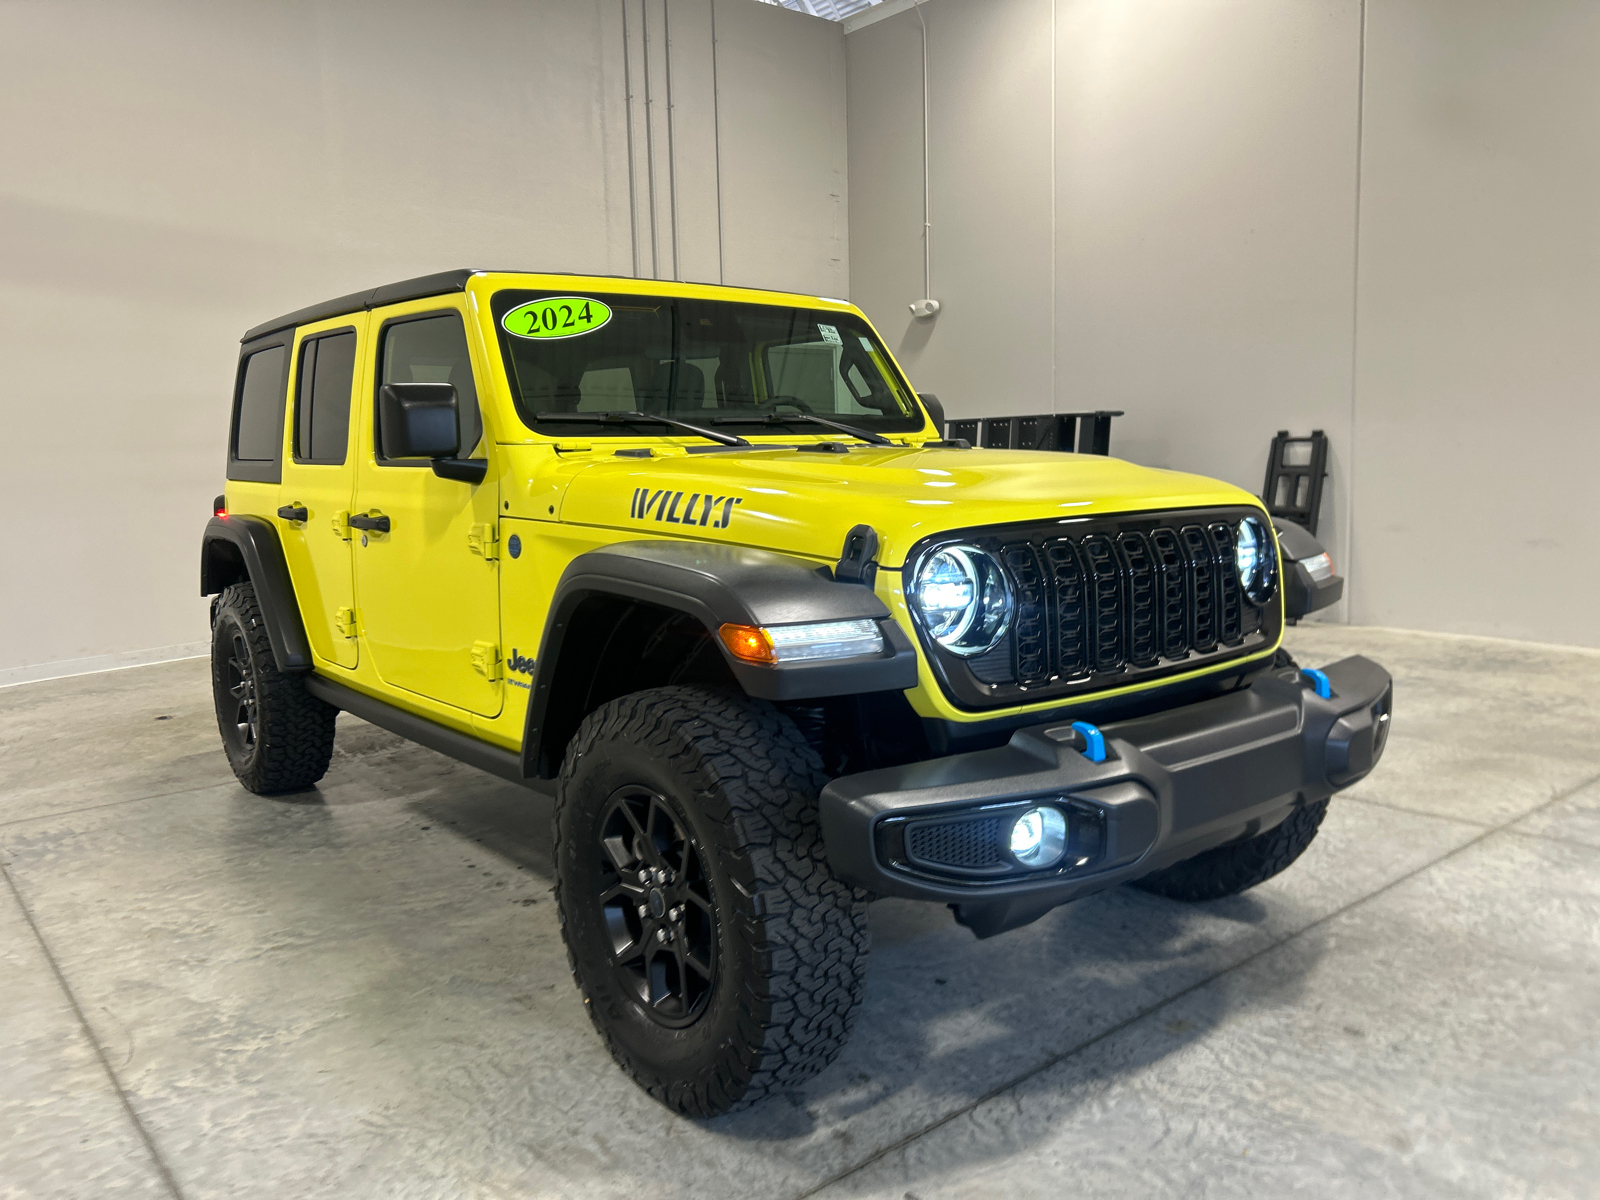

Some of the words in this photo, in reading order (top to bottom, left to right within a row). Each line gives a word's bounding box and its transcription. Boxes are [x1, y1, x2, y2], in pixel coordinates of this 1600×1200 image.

[523, 301, 594, 335] 2024
[630, 487, 744, 529] WILLYS
[507, 647, 536, 677] Jee
